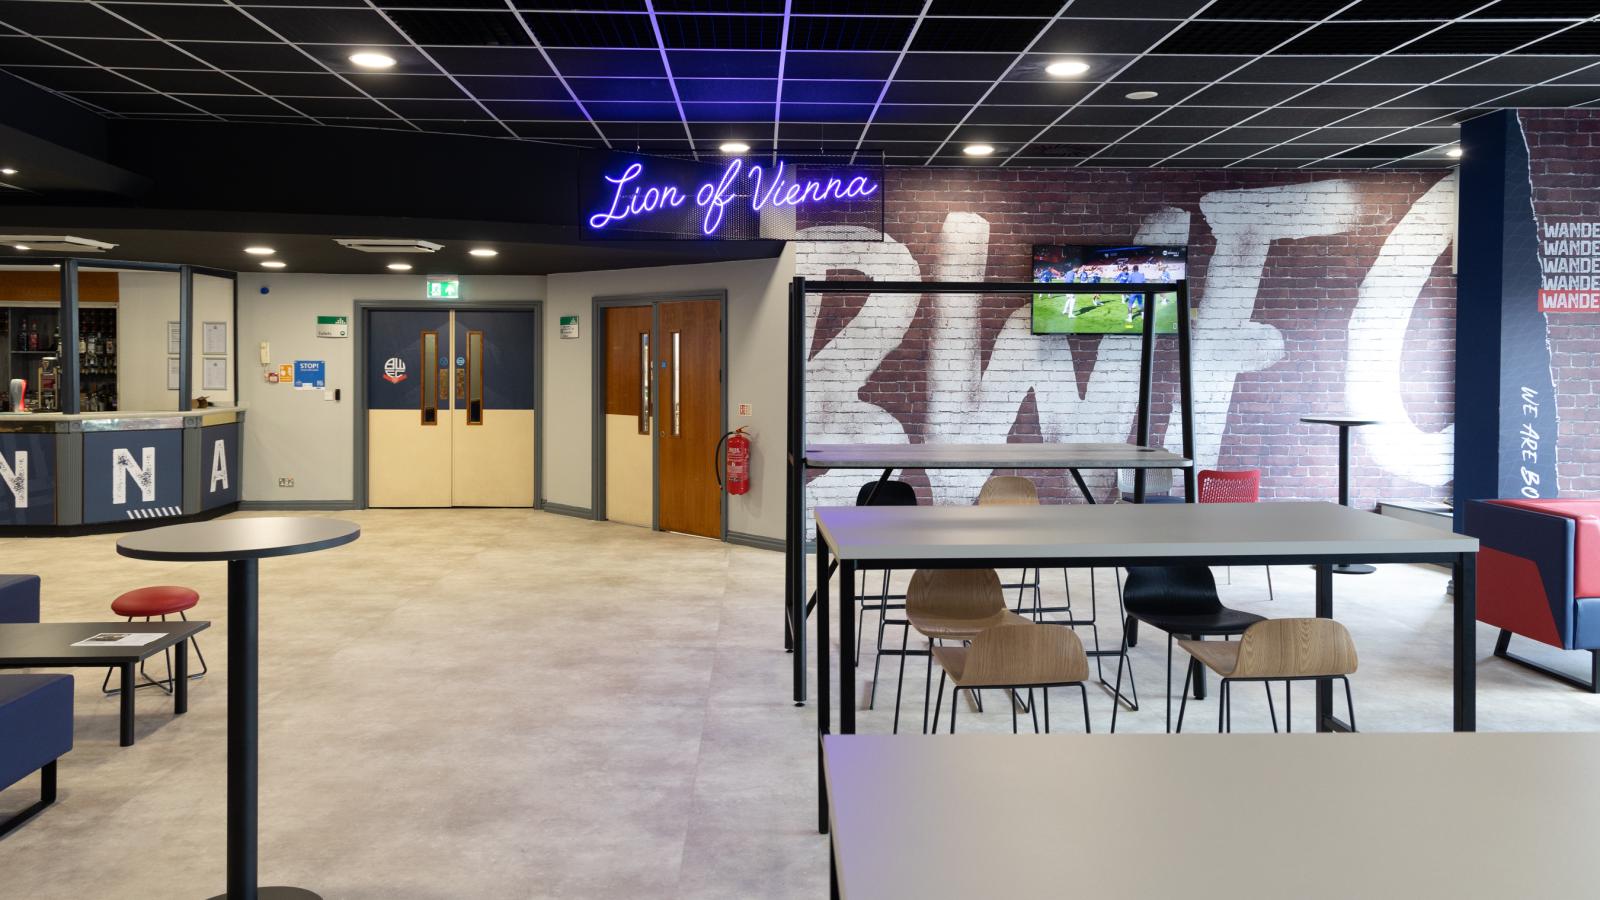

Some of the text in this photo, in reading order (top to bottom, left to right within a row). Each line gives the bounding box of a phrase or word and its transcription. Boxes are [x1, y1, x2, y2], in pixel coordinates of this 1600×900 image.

[589, 158, 878, 235] Lion of Vienna
[796, 174, 1455, 541] BWFC
[1520, 386, 1540, 419] WE
[1519, 423, 1540, 464] ARE
